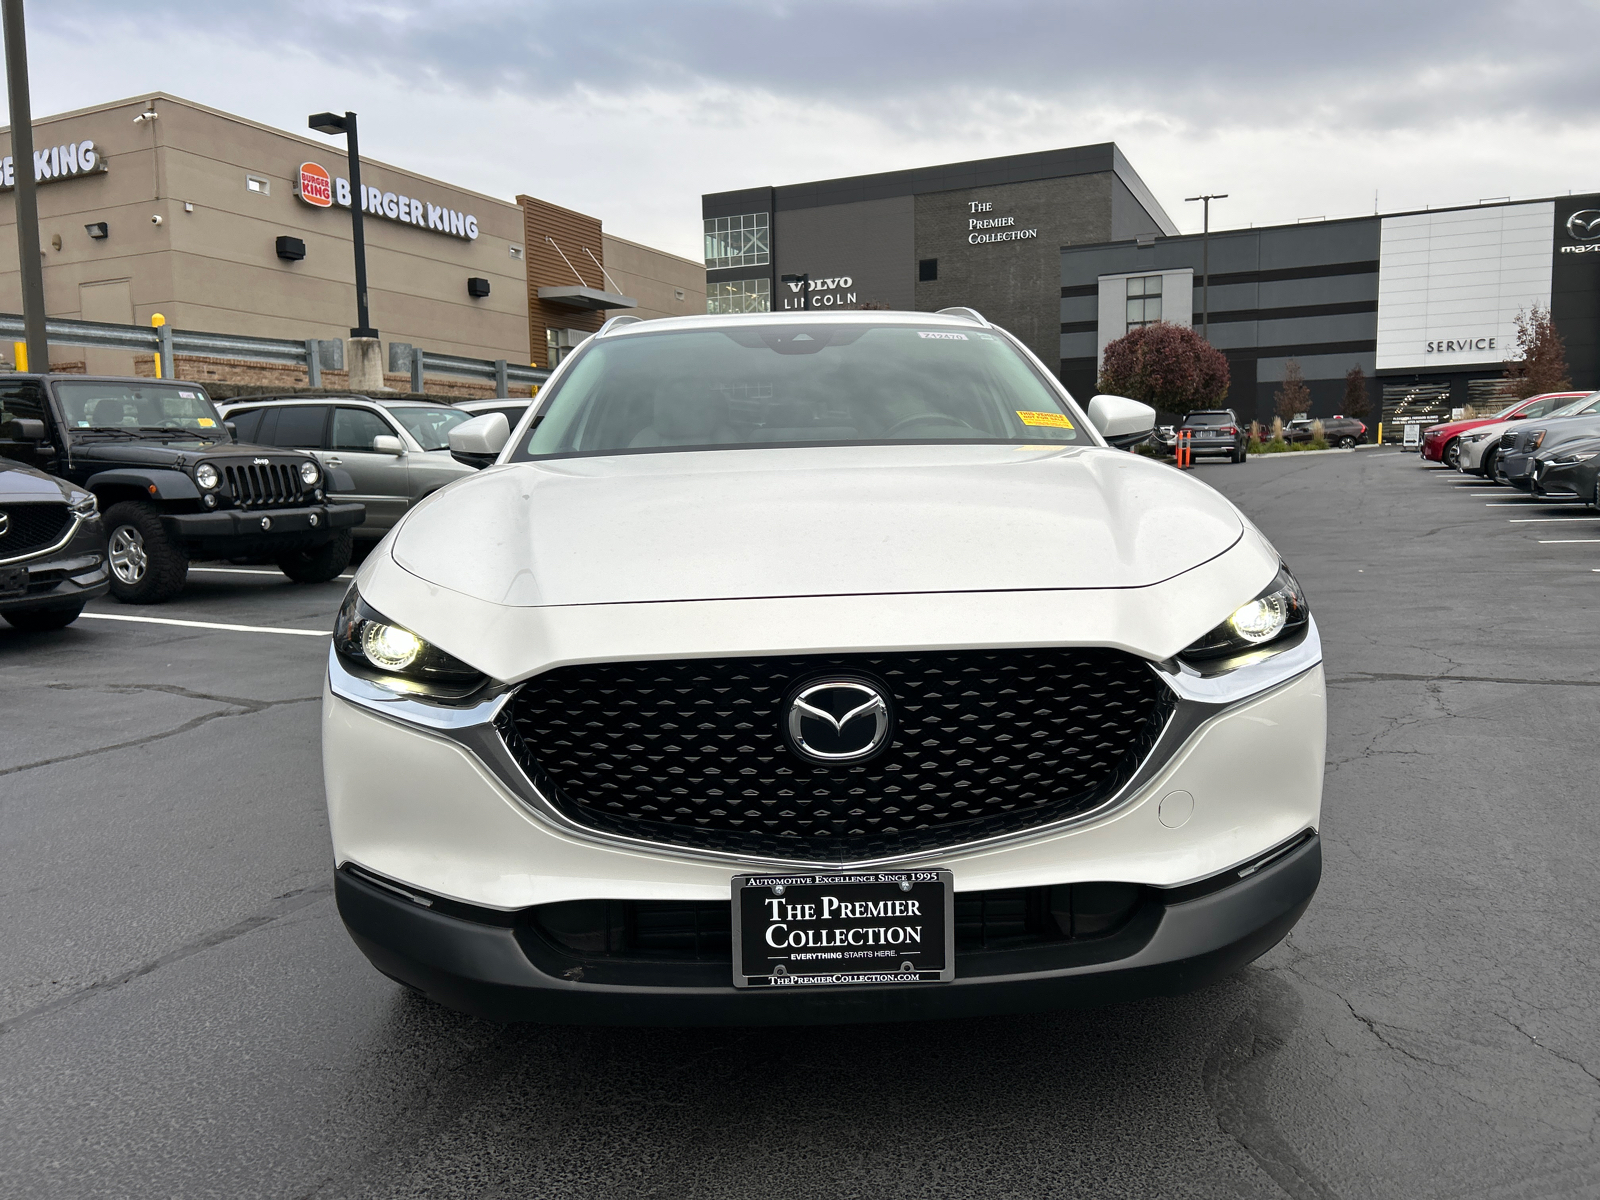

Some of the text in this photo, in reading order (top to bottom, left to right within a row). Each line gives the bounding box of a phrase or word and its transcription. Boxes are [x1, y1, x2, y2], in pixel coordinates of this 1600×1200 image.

[33, 140, 95, 181] KING
[301, 173, 330, 189] BURGER
[302, 183, 331, 200] KING
[968, 201, 993, 213] THE
[427, 202, 479, 241] KING
[968, 216, 1015, 231] PREMIER
[968, 228, 1038, 245] COLLECTION
[787, 276, 853, 293] VOLVO
[1426, 338, 1496, 353] SERVICE
[748, 872, 938, 886] AUTOMOTIVE EXCELLENCE SINCE 1995
[765, 896, 922, 922] THE PREMIER
[765, 923, 922, 948] COLLECTION
[790, 950, 898, 960] EVERYTHING STARTS HERE.
[768, 973, 920, 985] THEPREMIERCOLLECTION.COM
